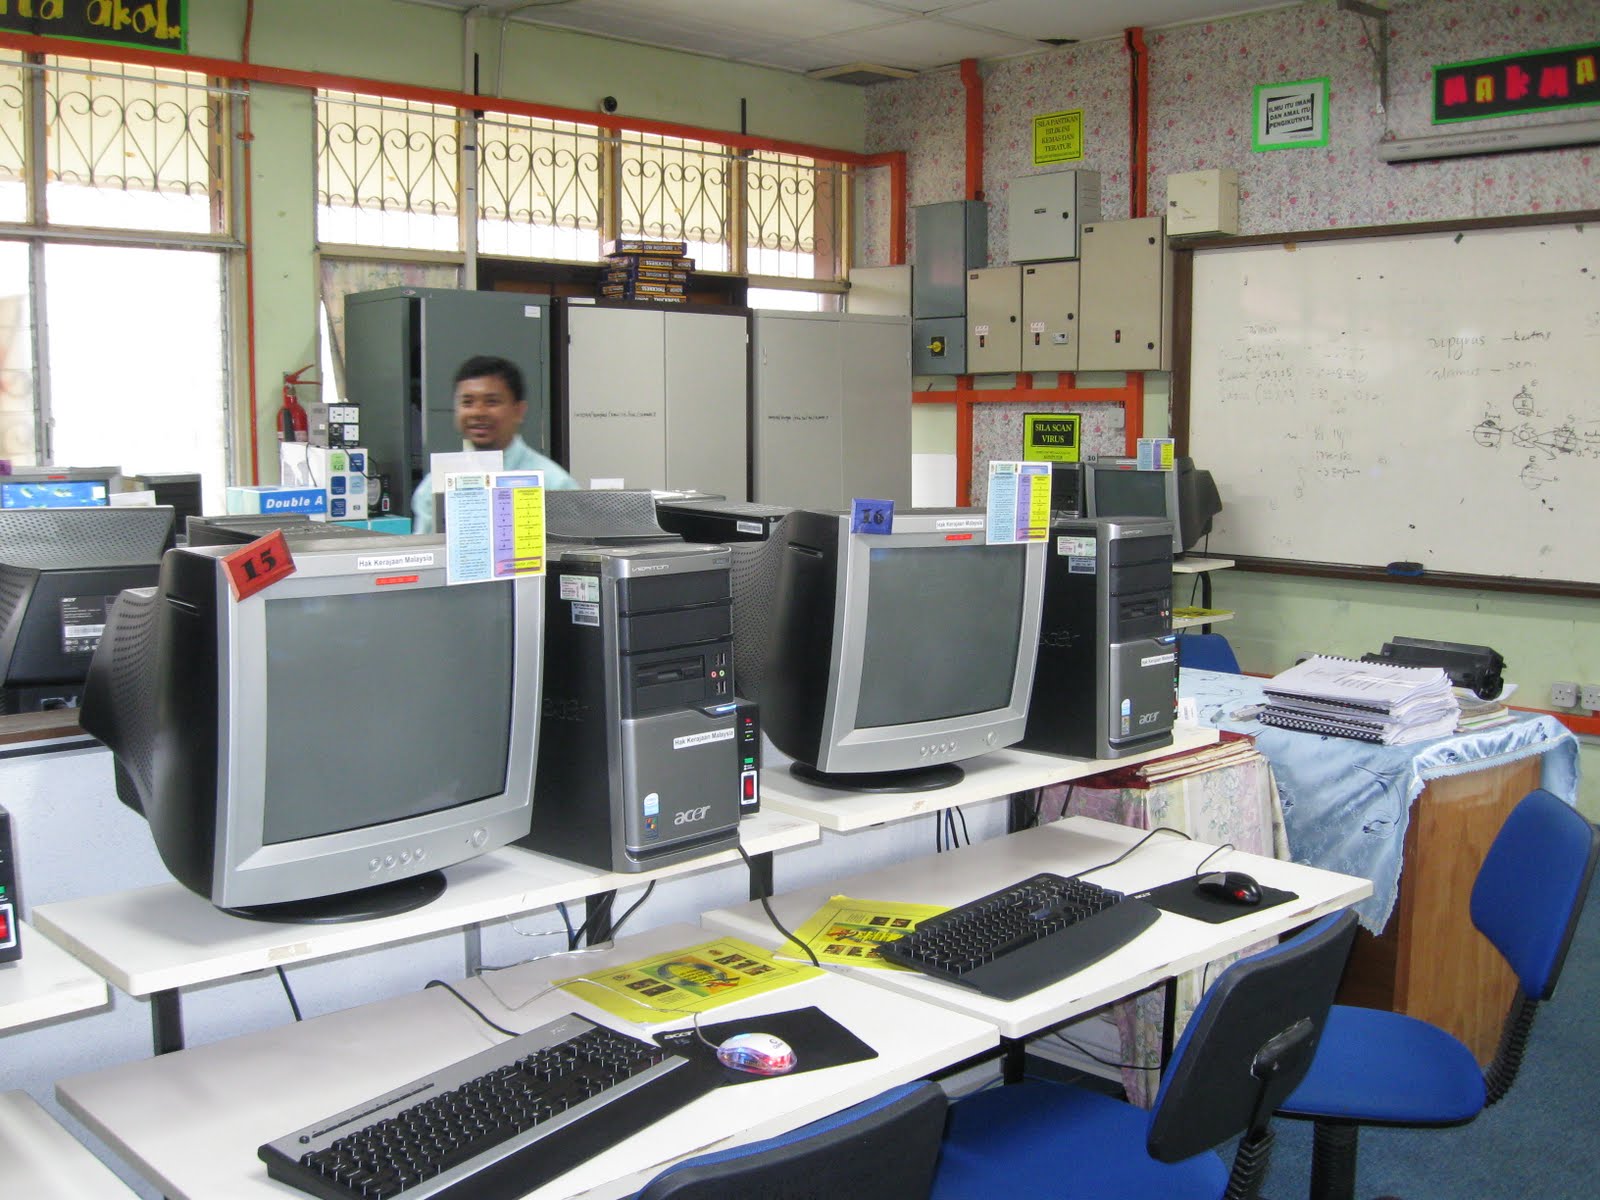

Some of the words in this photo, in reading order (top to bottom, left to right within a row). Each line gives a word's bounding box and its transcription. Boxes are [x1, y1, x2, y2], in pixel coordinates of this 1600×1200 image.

[1283, 109, 1300, 117] AMAL
[266, 495, 310, 509] Double
[314, 496, 323, 505] A
[861, 509, 885, 525] 16
[240, 548, 277, 583] 15
[359, 559, 372, 567] Hak
[374, 557, 403, 567] Kerajaan
[404, 554, 433, 564] Malaysia
[1139, 711, 1160, 725] acer
[674, 737, 686, 745] Hak
[687, 733, 711, 744] Kerajaan
[712, 729, 734, 740] Malaysia
[674, 805, 711, 825] acer
[663, 1030, 695, 1040] acer
